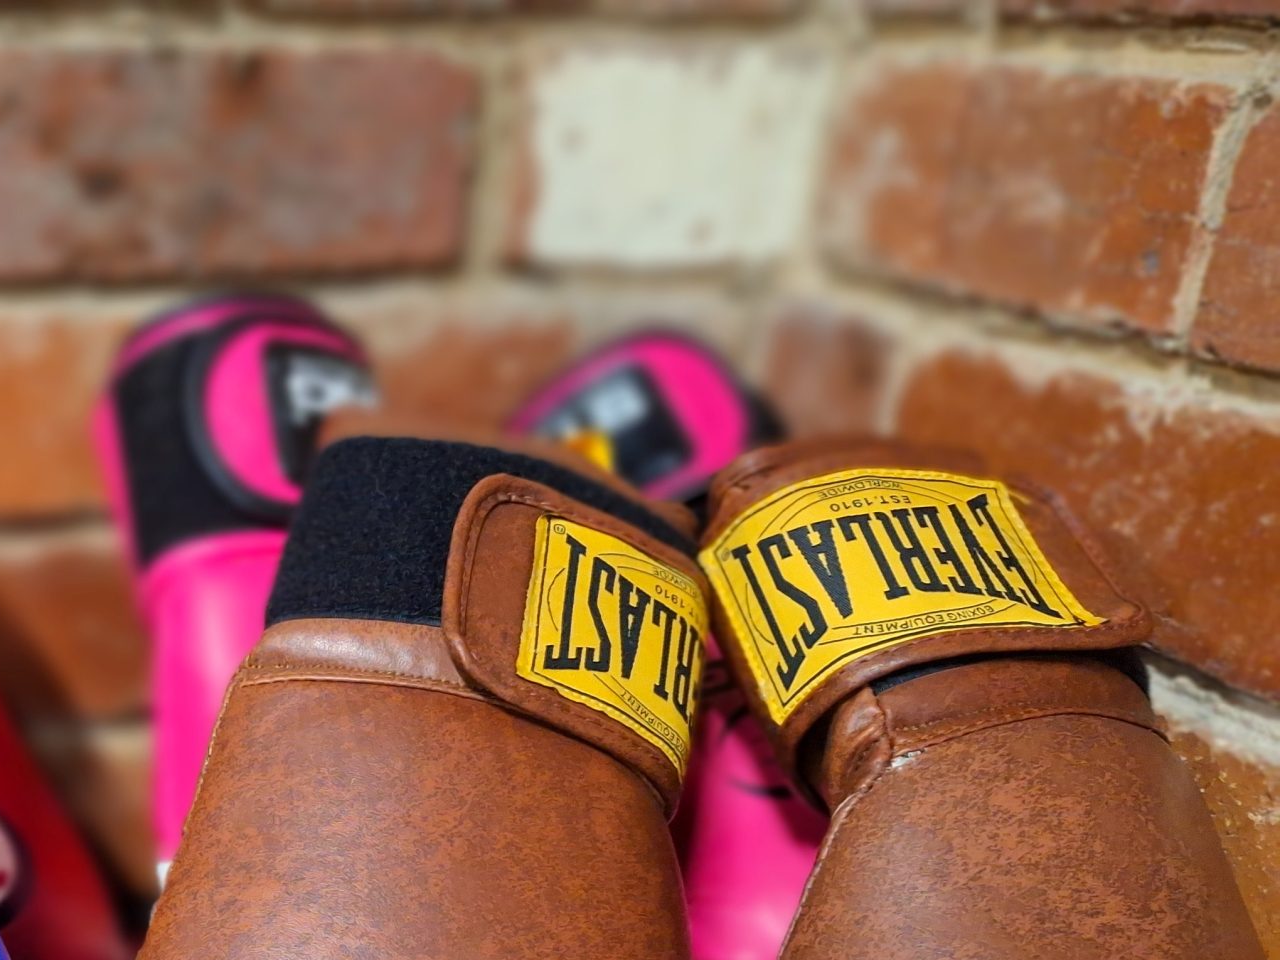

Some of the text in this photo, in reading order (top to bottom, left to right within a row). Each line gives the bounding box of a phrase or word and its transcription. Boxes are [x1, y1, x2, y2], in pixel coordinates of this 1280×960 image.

[818, 479, 903, 498] WORLDWIDE
[543, 533, 699, 726] RLAST
[731, 493, 1063, 692] EVERLAST
[851, 605, 995, 636] BOXING EQUIPMENT
